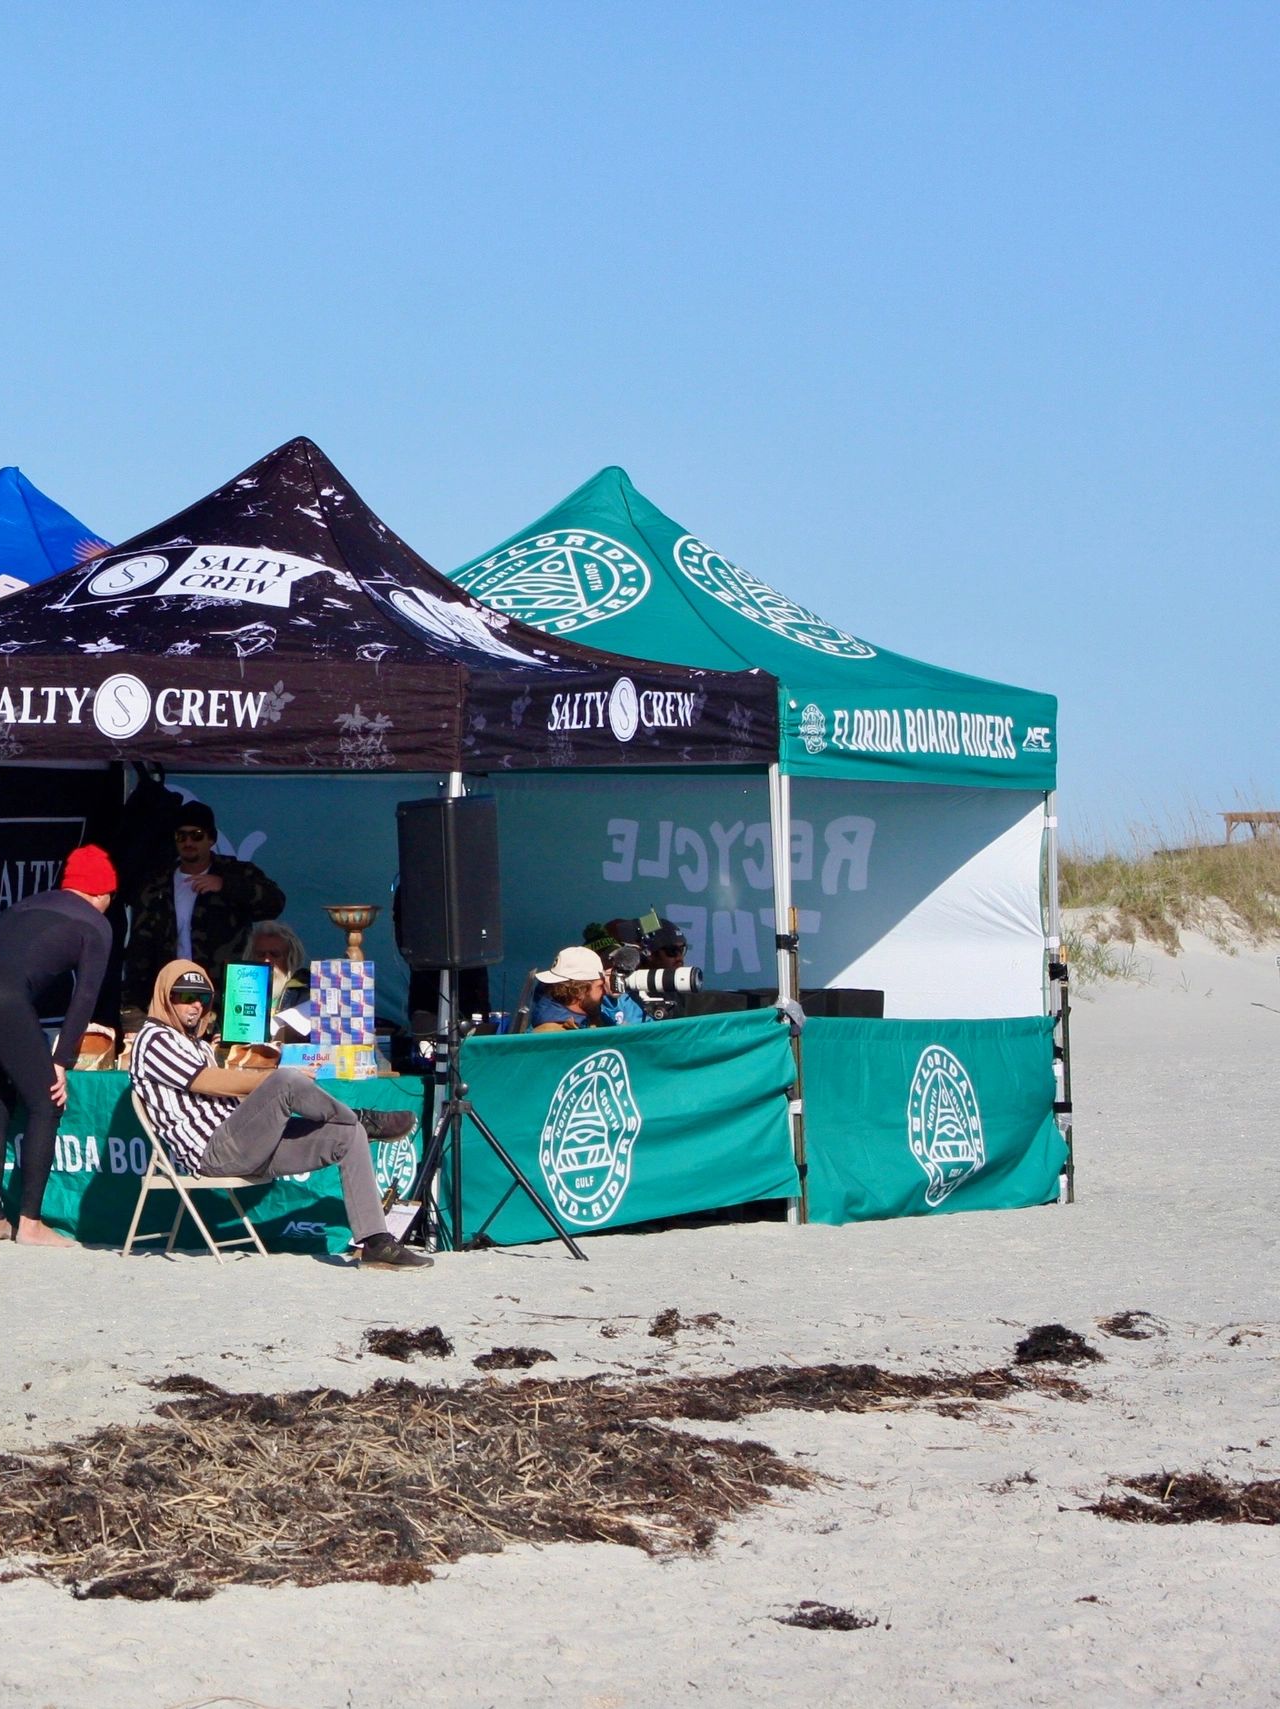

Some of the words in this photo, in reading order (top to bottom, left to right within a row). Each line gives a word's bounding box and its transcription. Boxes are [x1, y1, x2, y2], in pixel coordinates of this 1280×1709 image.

[193, 554, 299, 578] SALTY
[476, 560, 528, 590] NORTH
[481, 535, 638, 575] FLORIDA
[683, 543, 705, 576] FLO
[179, 574, 278, 595] CREW
[584, 562, 604, 591] SOUTH
[537, 586, 638, 632] DERS
[155, 688, 267, 728] CREW
[547, 691, 608, 731] SALTY
[640, 690, 695, 727] CREW
[831, 709, 905, 754] FLORIDA
[904, 708, 961, 755] BOARD
[960, 712, 1017, 760] RIDERS
[302, 1053, 315, 1061] Red
[316, 1053, 329, 1061] Bull
[916, 1053, 968, 1095] FLORIDA
[558, 1055, 625, 1102] FLORIDA
[555, 1093, 577, 1139] NORTH
[599, 1088, 620, 1131] SOUTH
[926, 1087, 938, 1130] NORTH
[542, 1126, 580, 1217] BOARD
[592, 1117, 637, 1217] RIDERS
[575, 1176, 594, 1189] GULF
